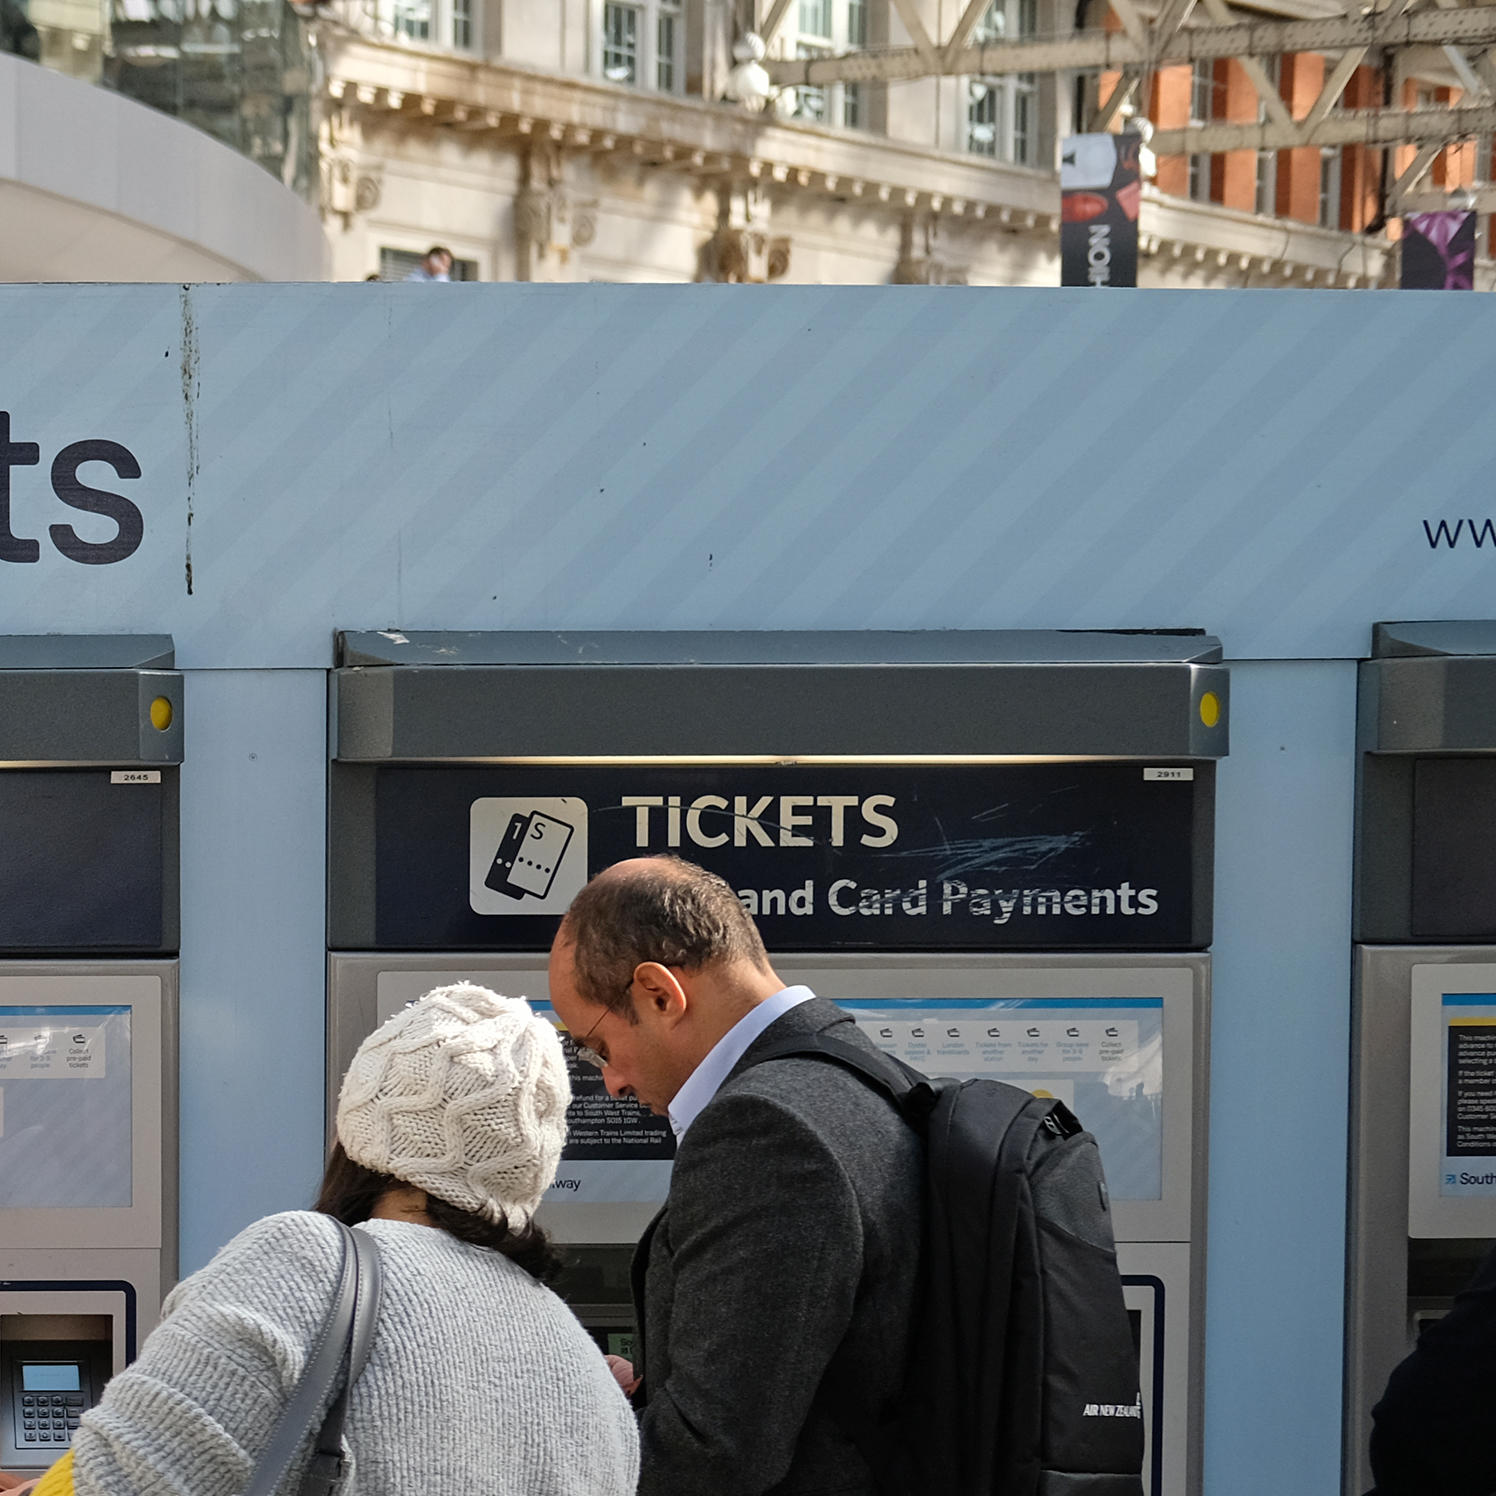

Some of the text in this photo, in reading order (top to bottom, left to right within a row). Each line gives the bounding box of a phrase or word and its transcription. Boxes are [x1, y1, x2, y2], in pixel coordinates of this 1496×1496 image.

[622, 795, 898, 848] TICKETS
[738, 880, 1158, 923] and Card Payments
[1460, 1173, 1496, 1185] South
[1083, 1404, 1099, 1416] AIR
[1100, 1404, 1115, 1417] NEW
